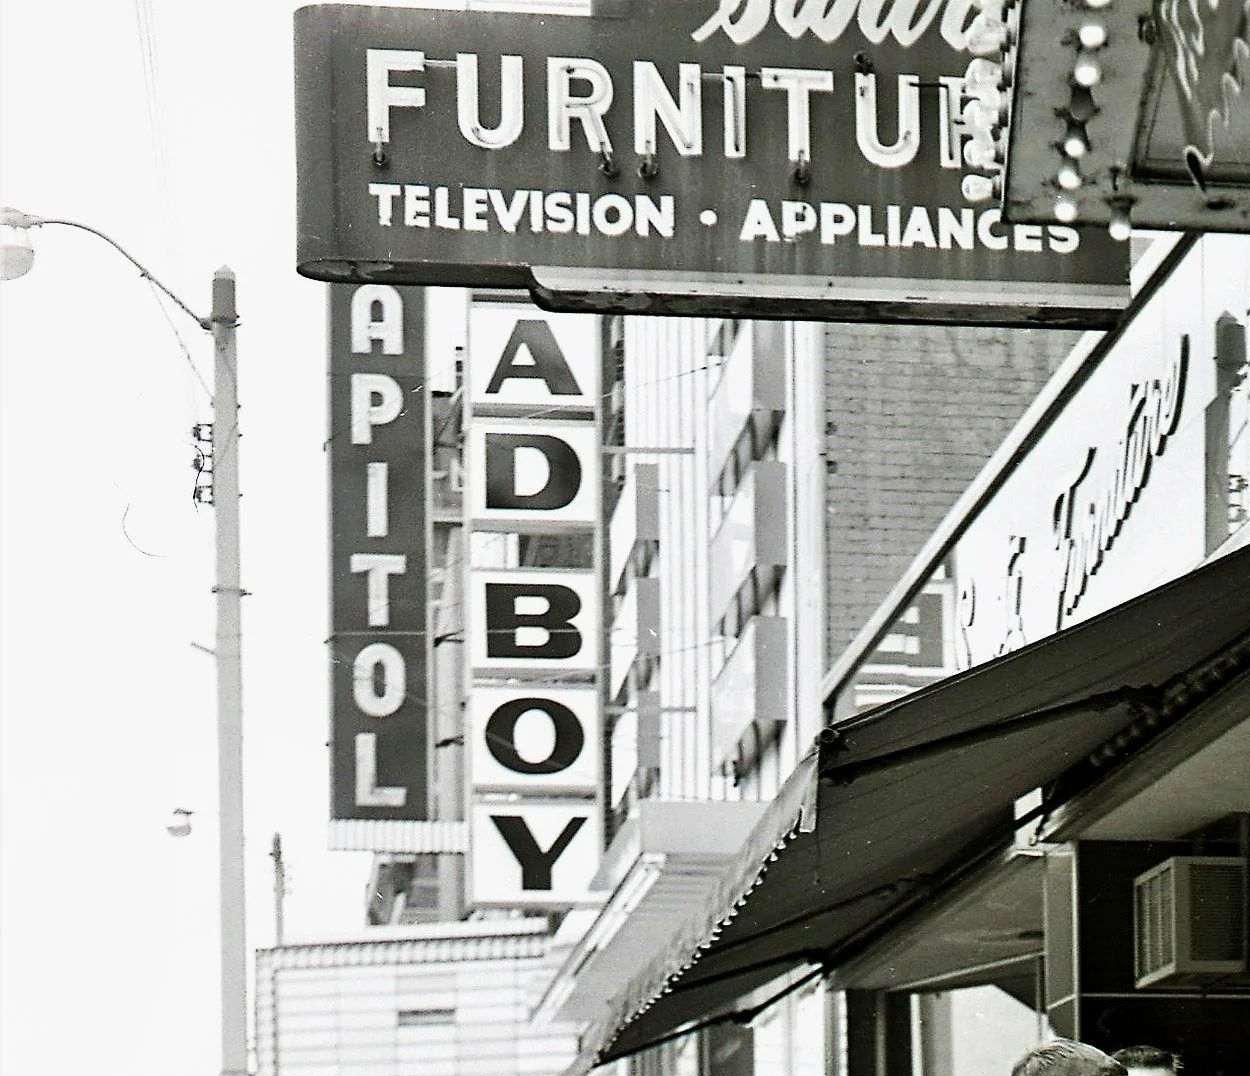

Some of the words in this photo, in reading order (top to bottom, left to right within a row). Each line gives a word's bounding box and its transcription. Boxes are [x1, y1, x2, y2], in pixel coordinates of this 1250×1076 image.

[369, 183, 675, 238] TELEVISION
[739, 198, 1080, 253] APPLIANCES
[350, 283, 408, 808] APITOL
